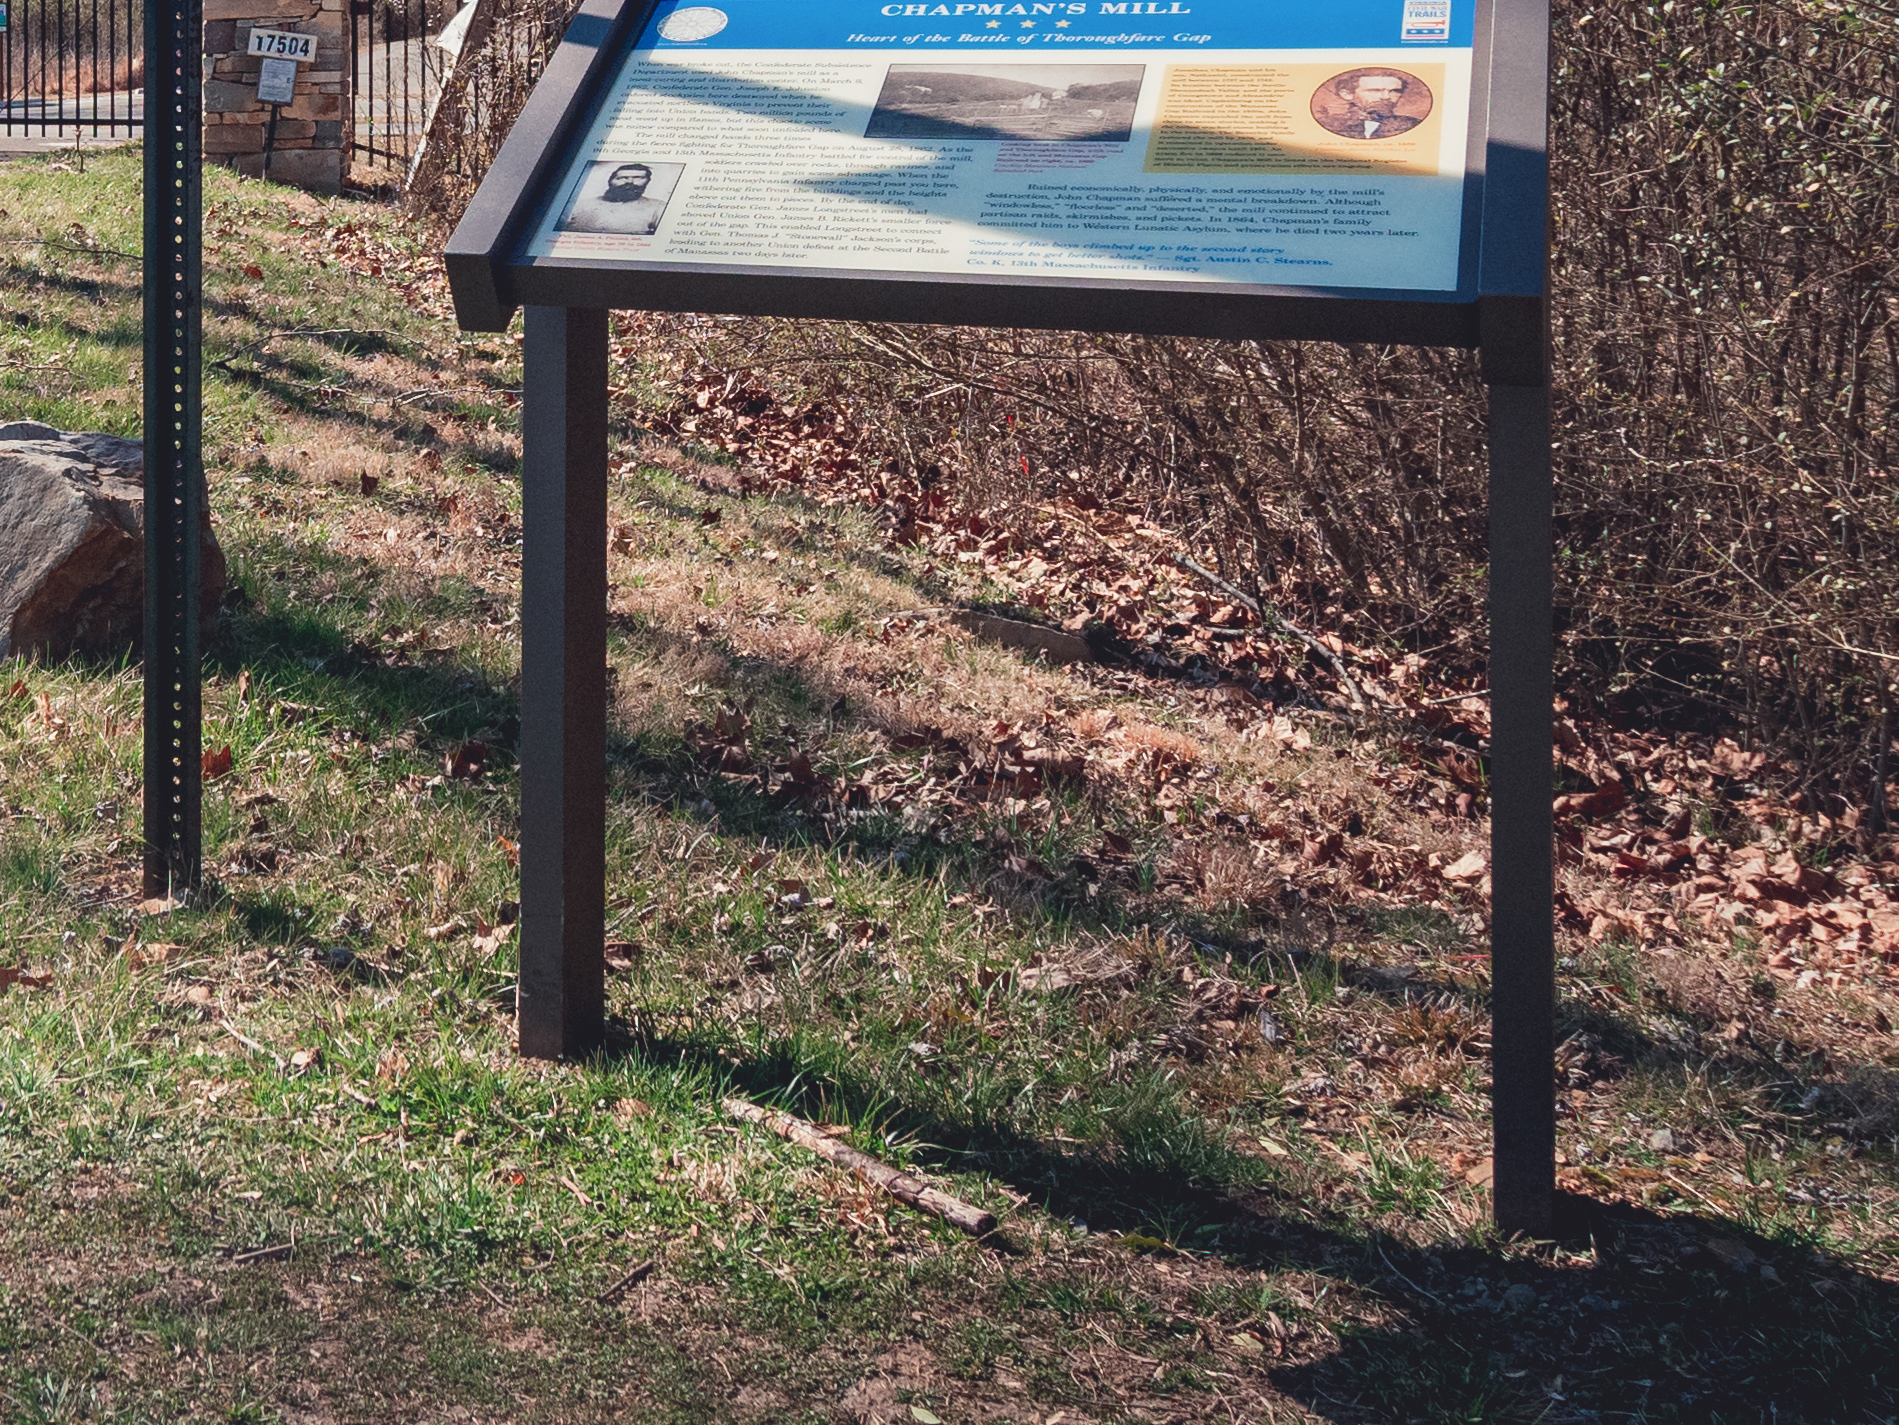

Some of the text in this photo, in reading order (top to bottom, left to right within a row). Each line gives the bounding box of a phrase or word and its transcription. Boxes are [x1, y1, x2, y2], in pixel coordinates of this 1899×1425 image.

[880, 2, 1191, 16] CHAPMAN'S MILL
[846, 33, 1212, 45] Heart of the Battle of Thoroughfare Gap
[256, 34, 310, 56] 17504
[1310, 188, 1324, 196] by
[1325, 198, 1380, 206] Although
[1083, 242, 1134, 250] climbed
